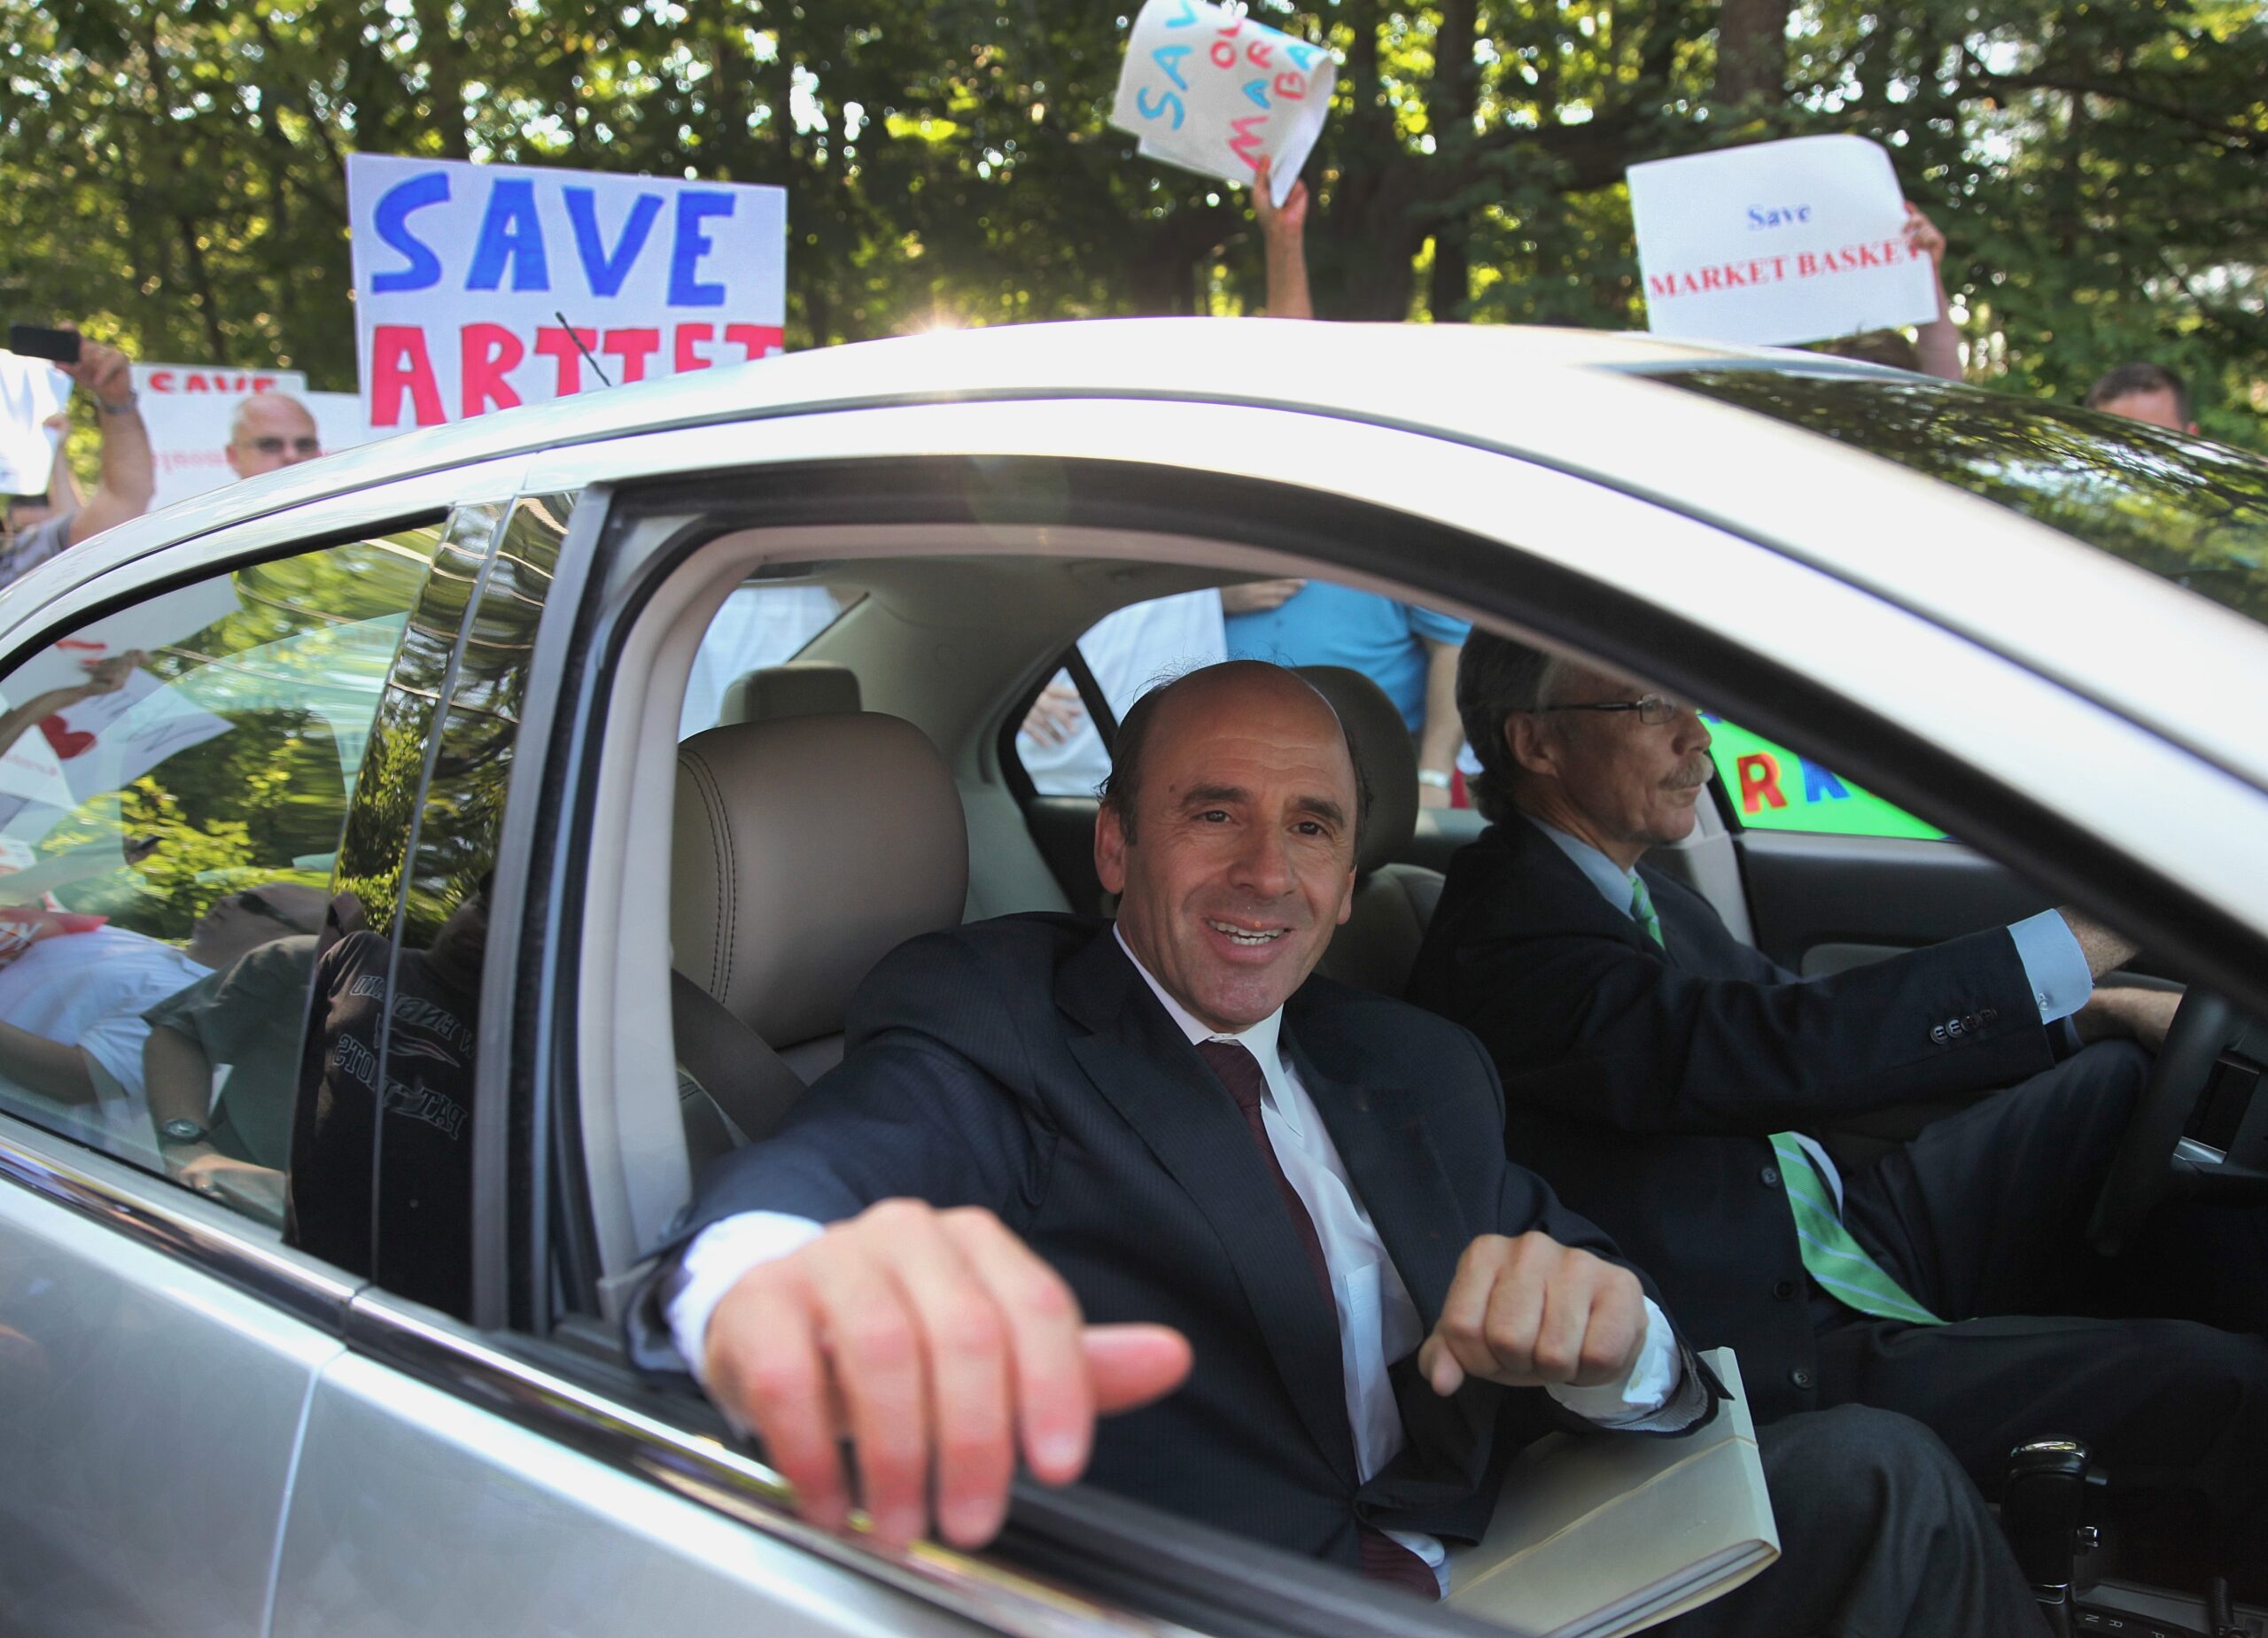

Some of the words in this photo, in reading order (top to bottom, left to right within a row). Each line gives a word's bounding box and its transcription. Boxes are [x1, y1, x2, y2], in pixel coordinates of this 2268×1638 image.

[1229, 24, 1285, 171] MAR
[370, 171, 736, 307] SAVE
[1746, 204, 1812, 230] Save
[1650, 256, 1789, 299] MARKET
[1798, 237, 1920, 279] BASKET
[2109, 1619, 2124, 1628] R
